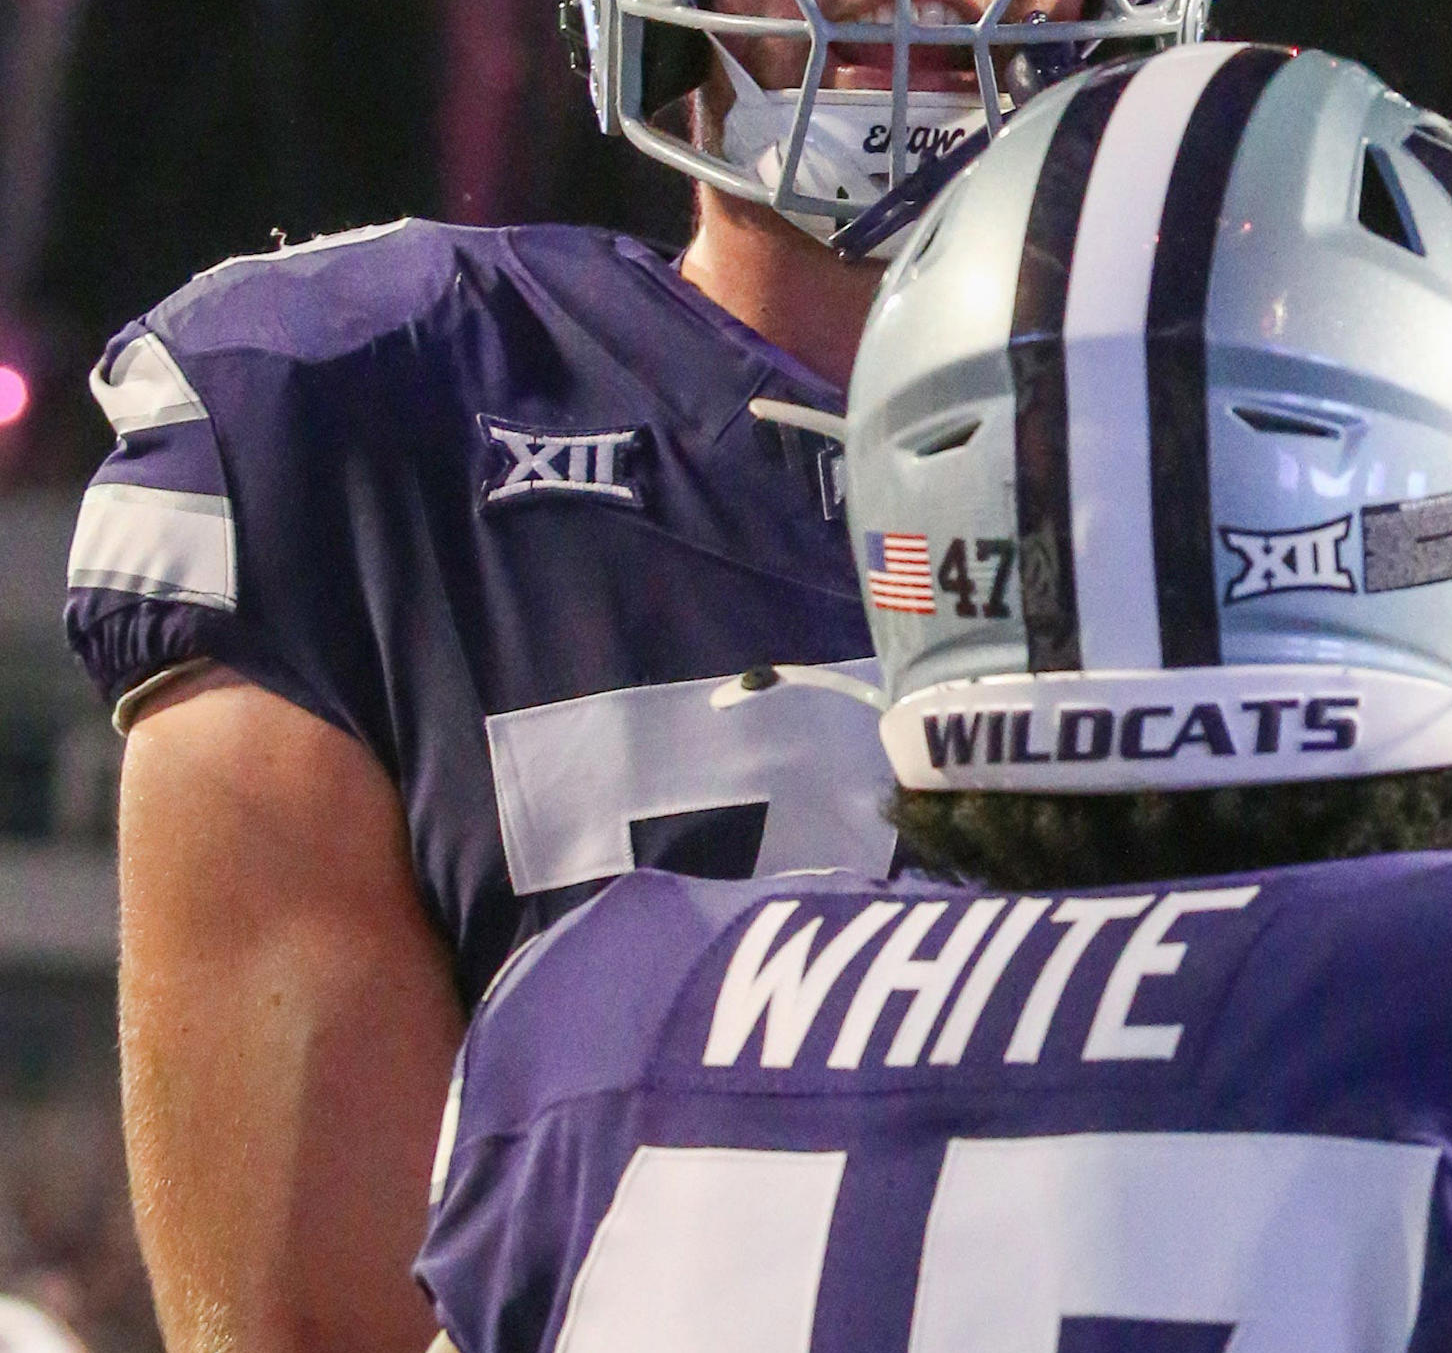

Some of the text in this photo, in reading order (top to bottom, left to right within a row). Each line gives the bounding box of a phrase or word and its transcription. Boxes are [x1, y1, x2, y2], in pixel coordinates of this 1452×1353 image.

[488, 425, 635, 502] XII
[938, 538, 1016, 618] 47
[1218, 513, 1356, 606] XII
[922, 696, 1360, 769] WILDCATS
[704, 886, 1261, 1070] WHITE
